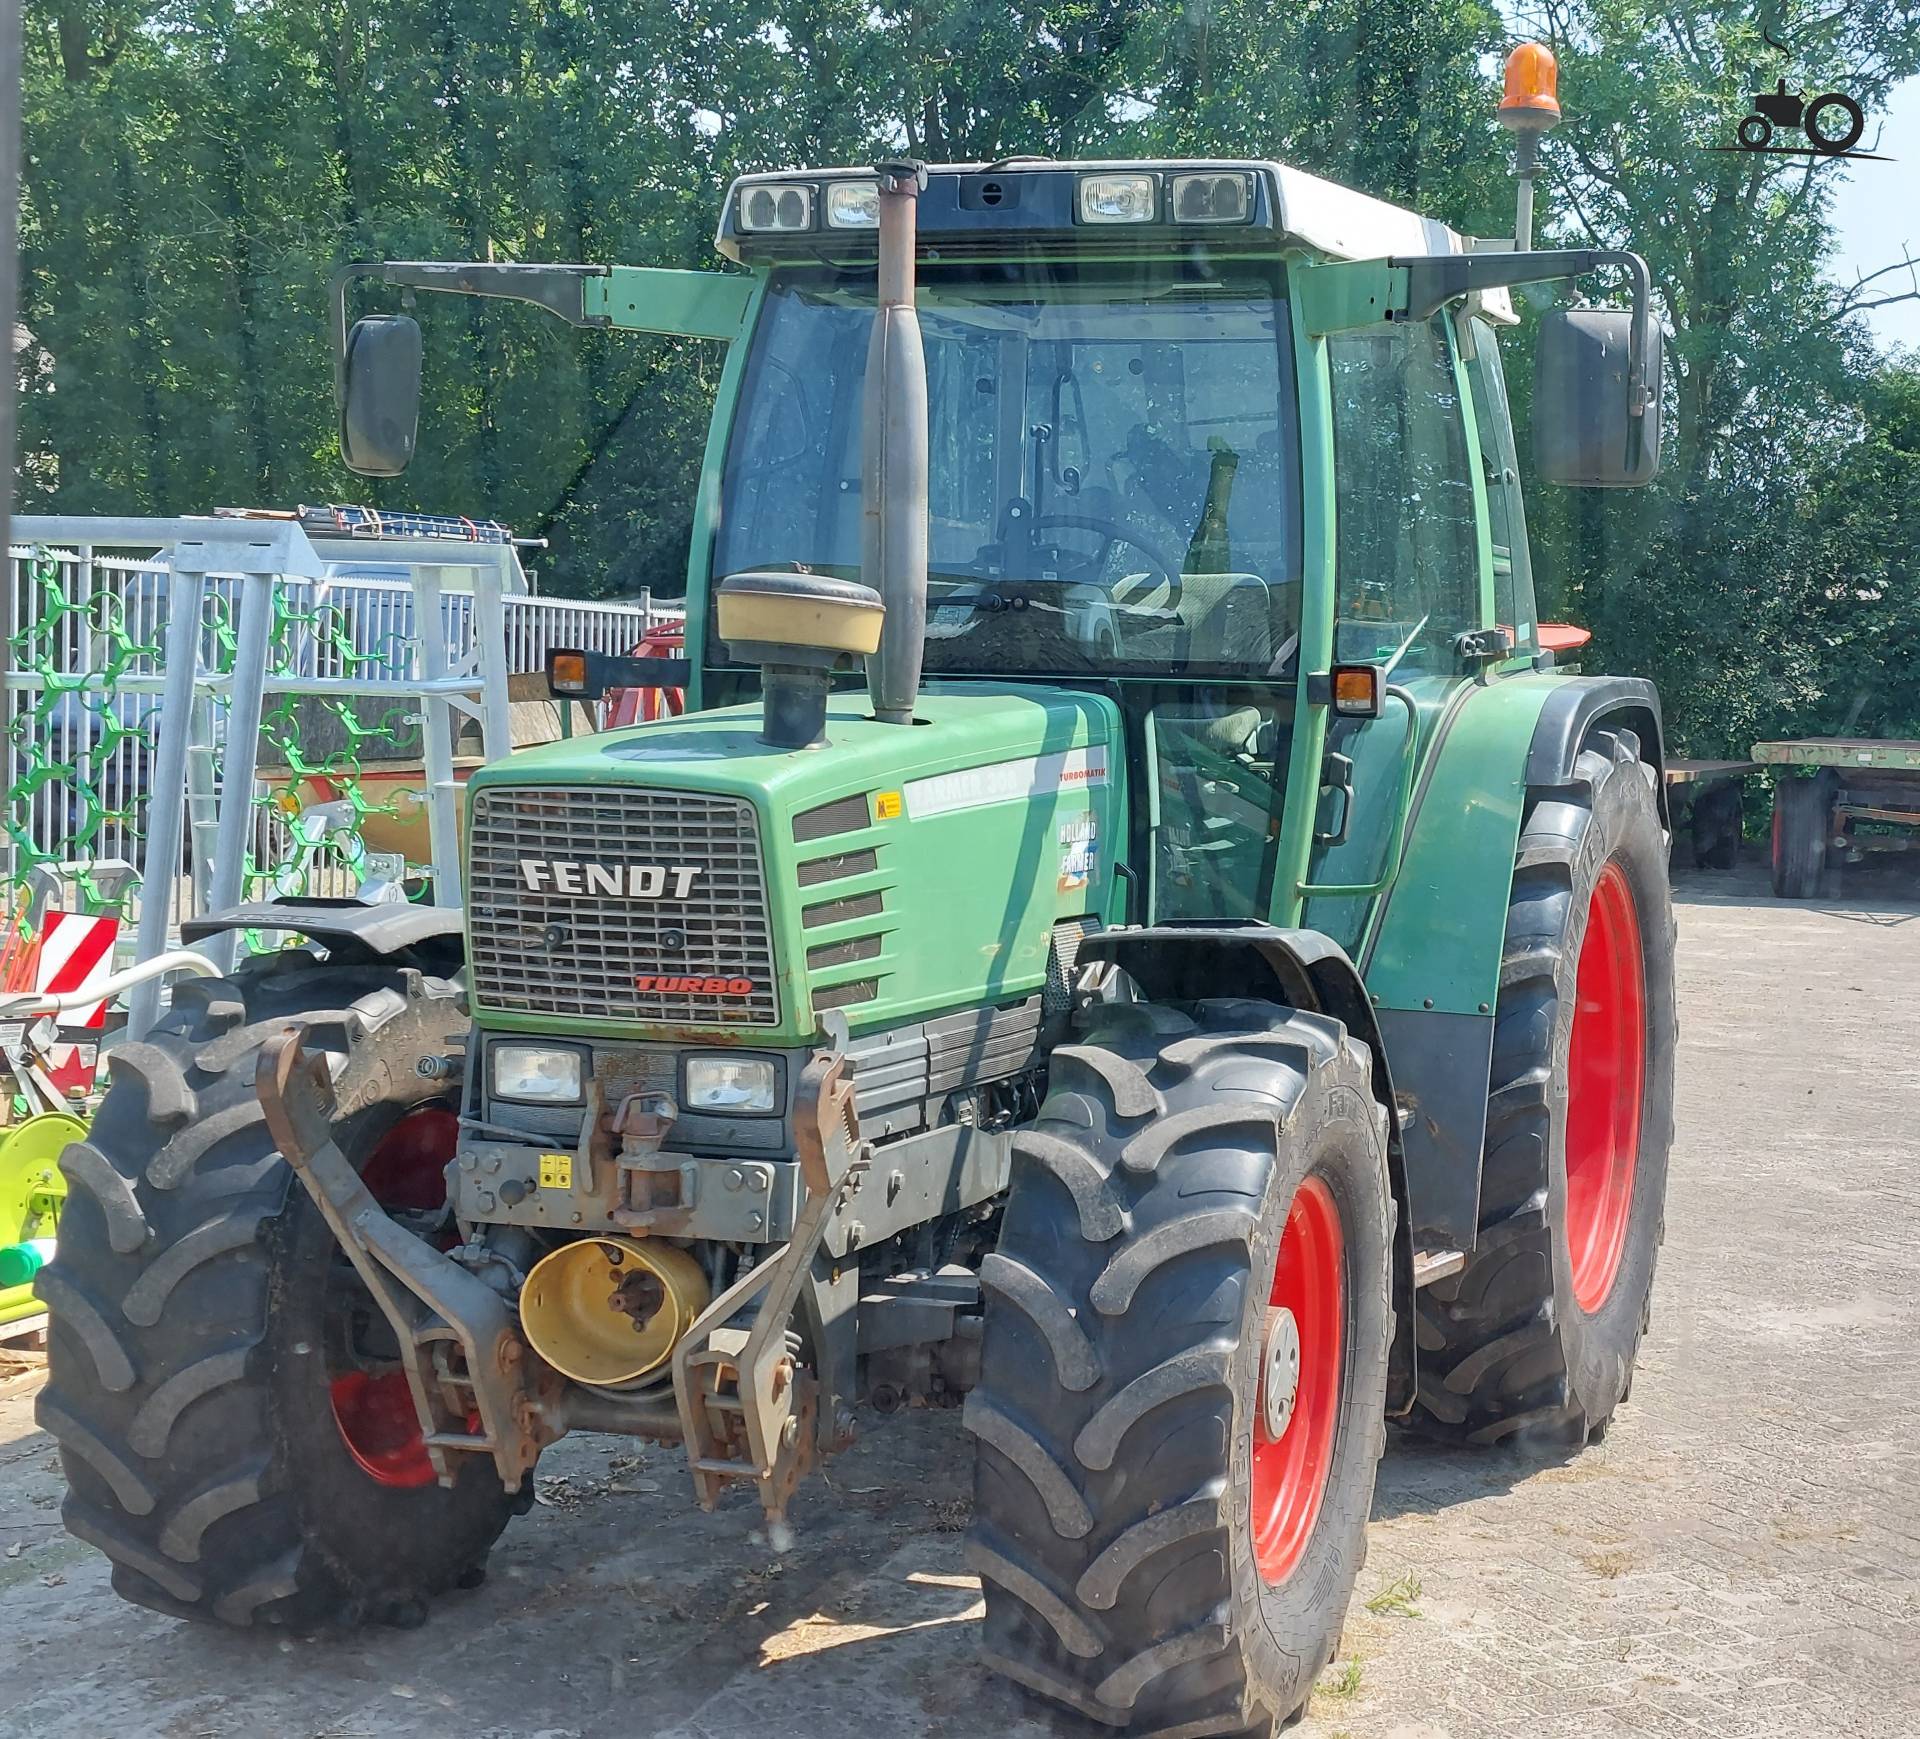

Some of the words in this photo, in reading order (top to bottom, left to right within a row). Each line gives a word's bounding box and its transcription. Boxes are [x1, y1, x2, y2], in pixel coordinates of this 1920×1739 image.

[1060, 768, 1106, 781] TURBOMATIK
[1060, 821, 1096, 844] HOLLAND
[1061, 852, 1095, 875] FARMER
[520, 859, 702, 898] FENDT
[636, 975, 753, 996] TURBO
